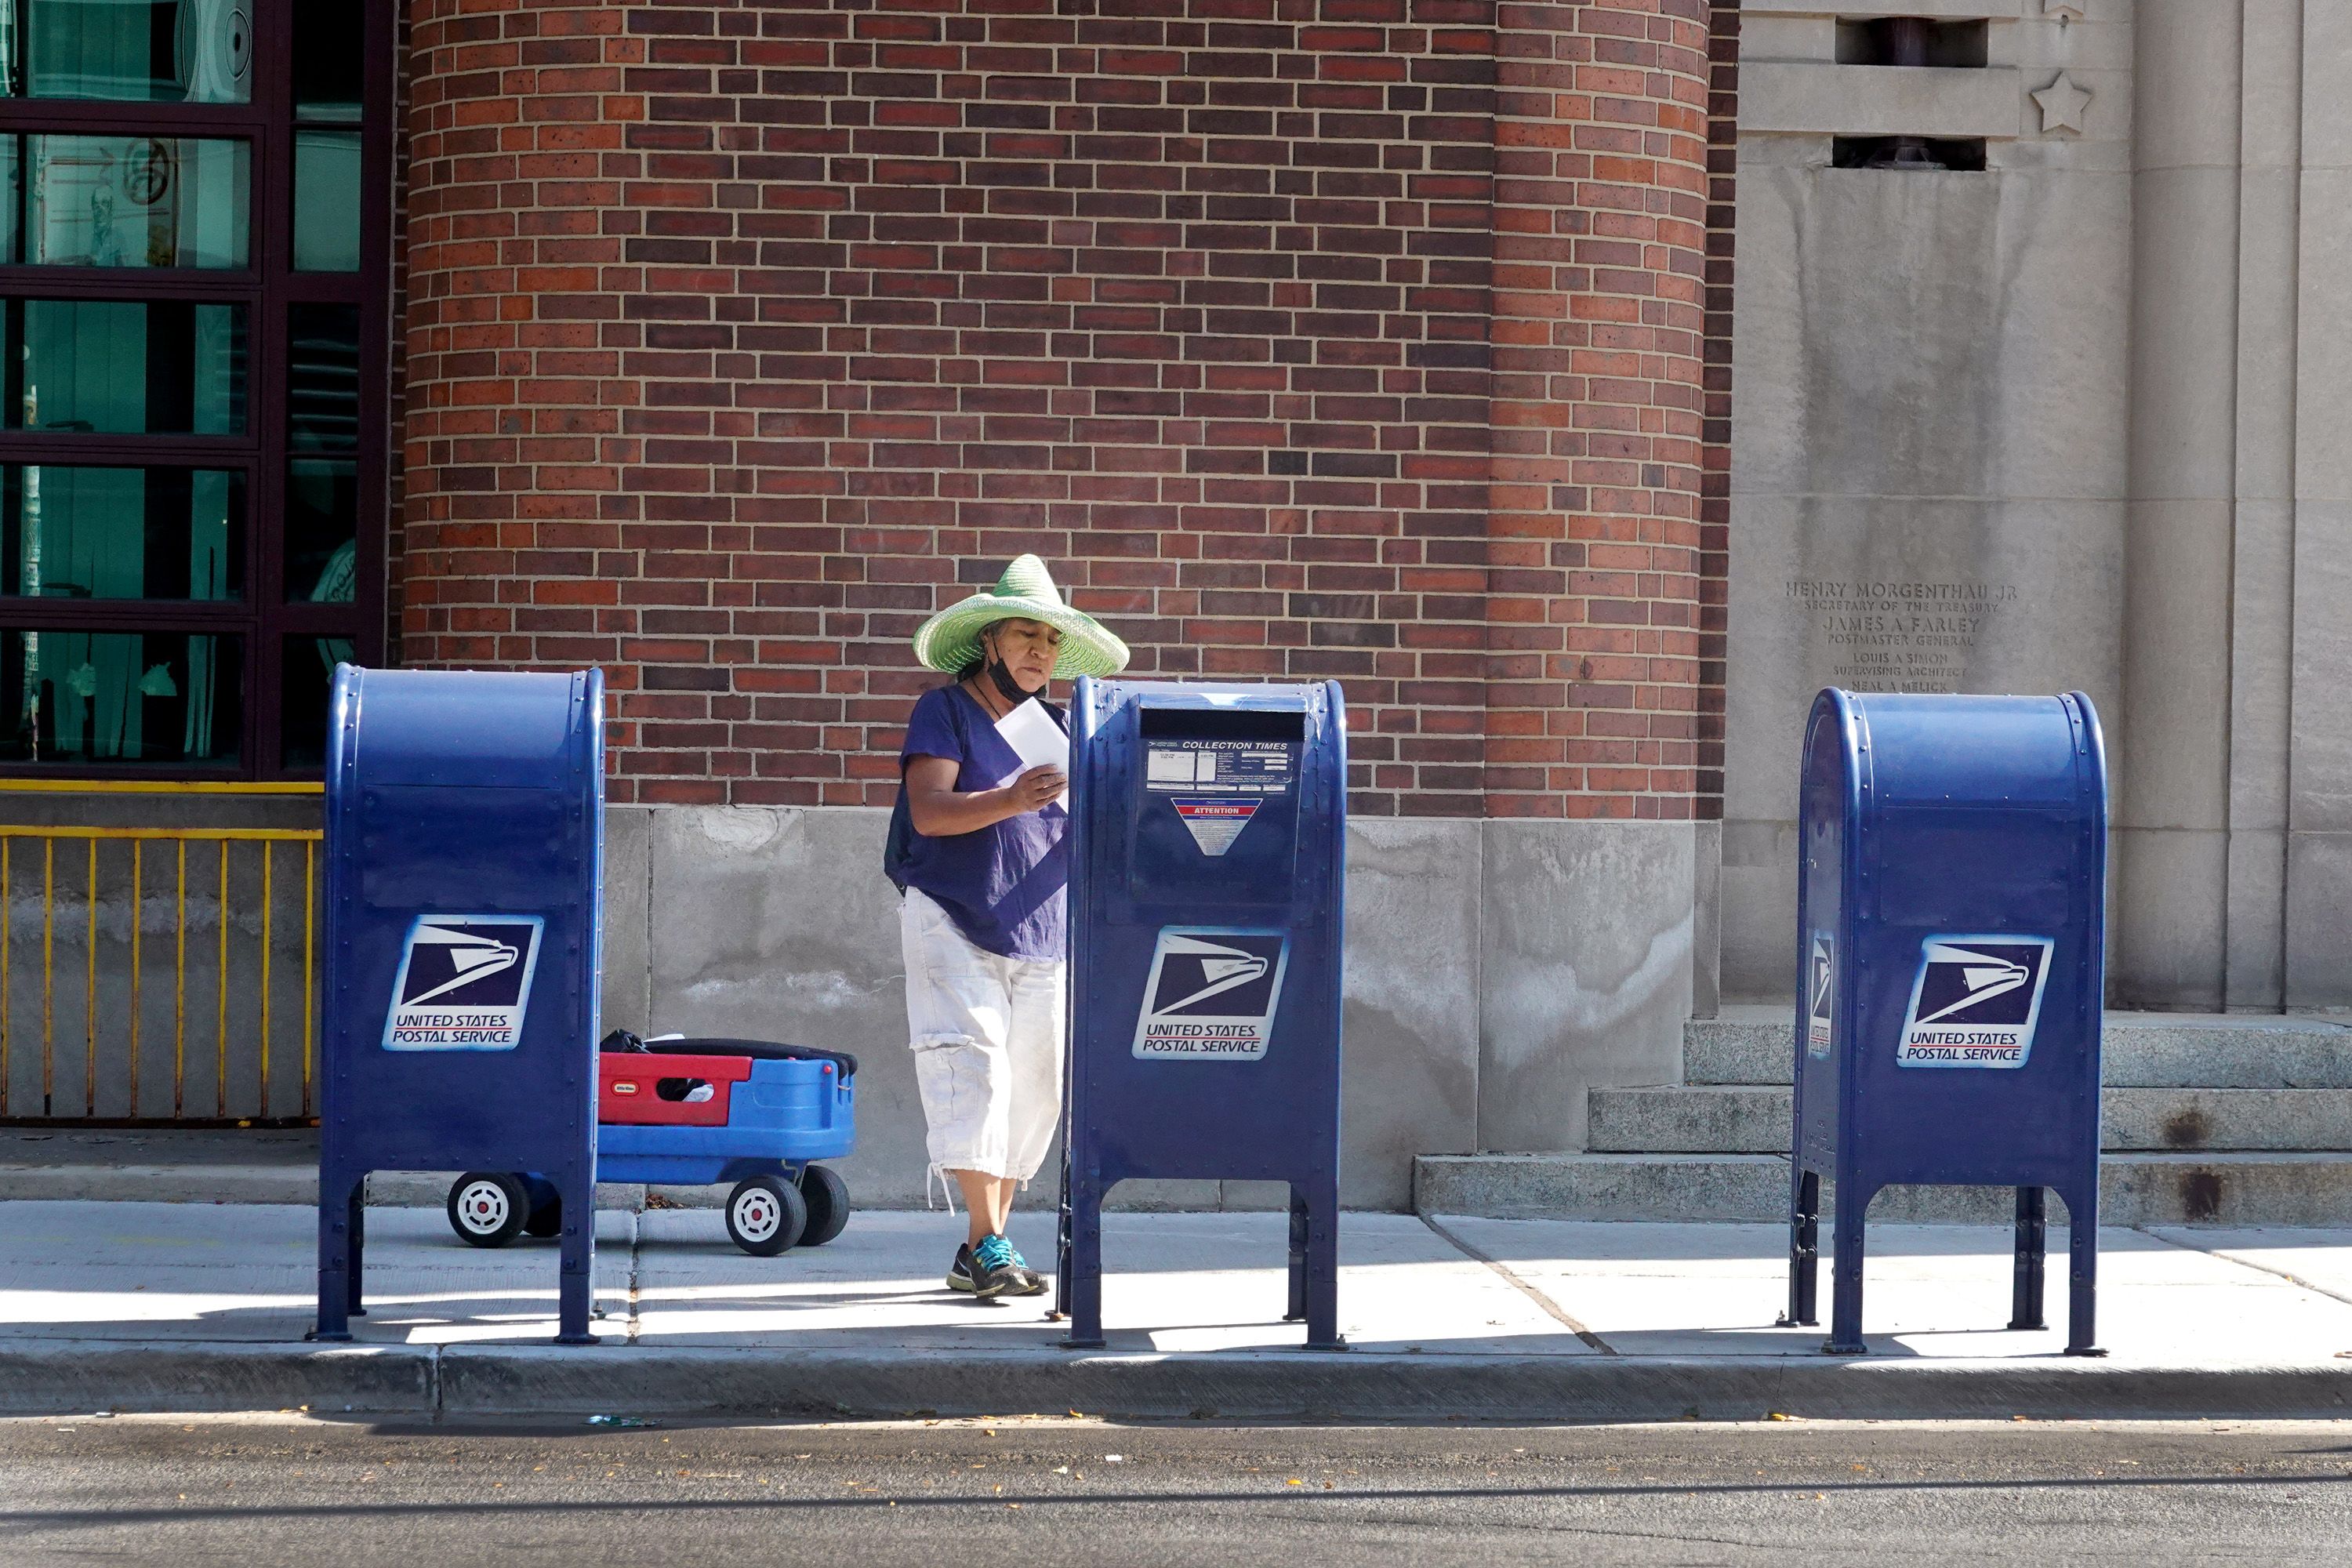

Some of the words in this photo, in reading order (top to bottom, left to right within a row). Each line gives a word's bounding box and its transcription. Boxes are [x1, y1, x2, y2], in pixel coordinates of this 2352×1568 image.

[1786, 582, 1846, 597] HENRY
[1856, 583, 1987, 599] MORGENTHAU
[1995, 586, 2017, 601] JR
[1804, 601, 1875, 612] SECRETARY
[1881, 601, 1898, 611] OF
[1906, 601, 1929, 612] THE
[1938, 601, 1998, 614] TREASURY
[1823, 616, 1883, 632] JAMES
[1893, 618, 1903, 632] A
[1911, 617, 1980, 633] FARLEY
[1828, 634, 1909, 646] POSTMASTER
[1916, 635, 1973, 647] GENERAL
[1853, 652, 1889, 663] LOUIS
[1894, 653, 1902, 663] A
[1907, 653, 1948, 663] SIMON
[1833, 666, 1901, 676] SUPERVISING
[1906, 666, 1967, 677] ARCHITECT
[1852, 681, 1884, 691] NEAL
[1901, 681, 1947, 691] MELICK
[1182, 741, 1252, 750] COLLECTION
[1255, 742, 1287, 750] TIMES
[396, 1014, 453, 1027] UNITED
[455, 1014, 507, 1027] STATES
[393, 1030, 448, 1044] POSTAL
[452, 1030, 511, 1044] SERVICE
[1147, 1024, 1203, 1037] UNITED
[1204, 1024, 1256, 1037] STATES
[1910, 1032, 1965, 1045] UNITED
[1967, 1033, 2017, 1045] STATES
[1143, 1040, 1198, 1052] POSTAL
[1201, 1040, 1260, 1053] SERVICE
[1907, 1048, 1959, 1060] POSTAL
[1962, 1048, 2021, 1061] SERVICE
